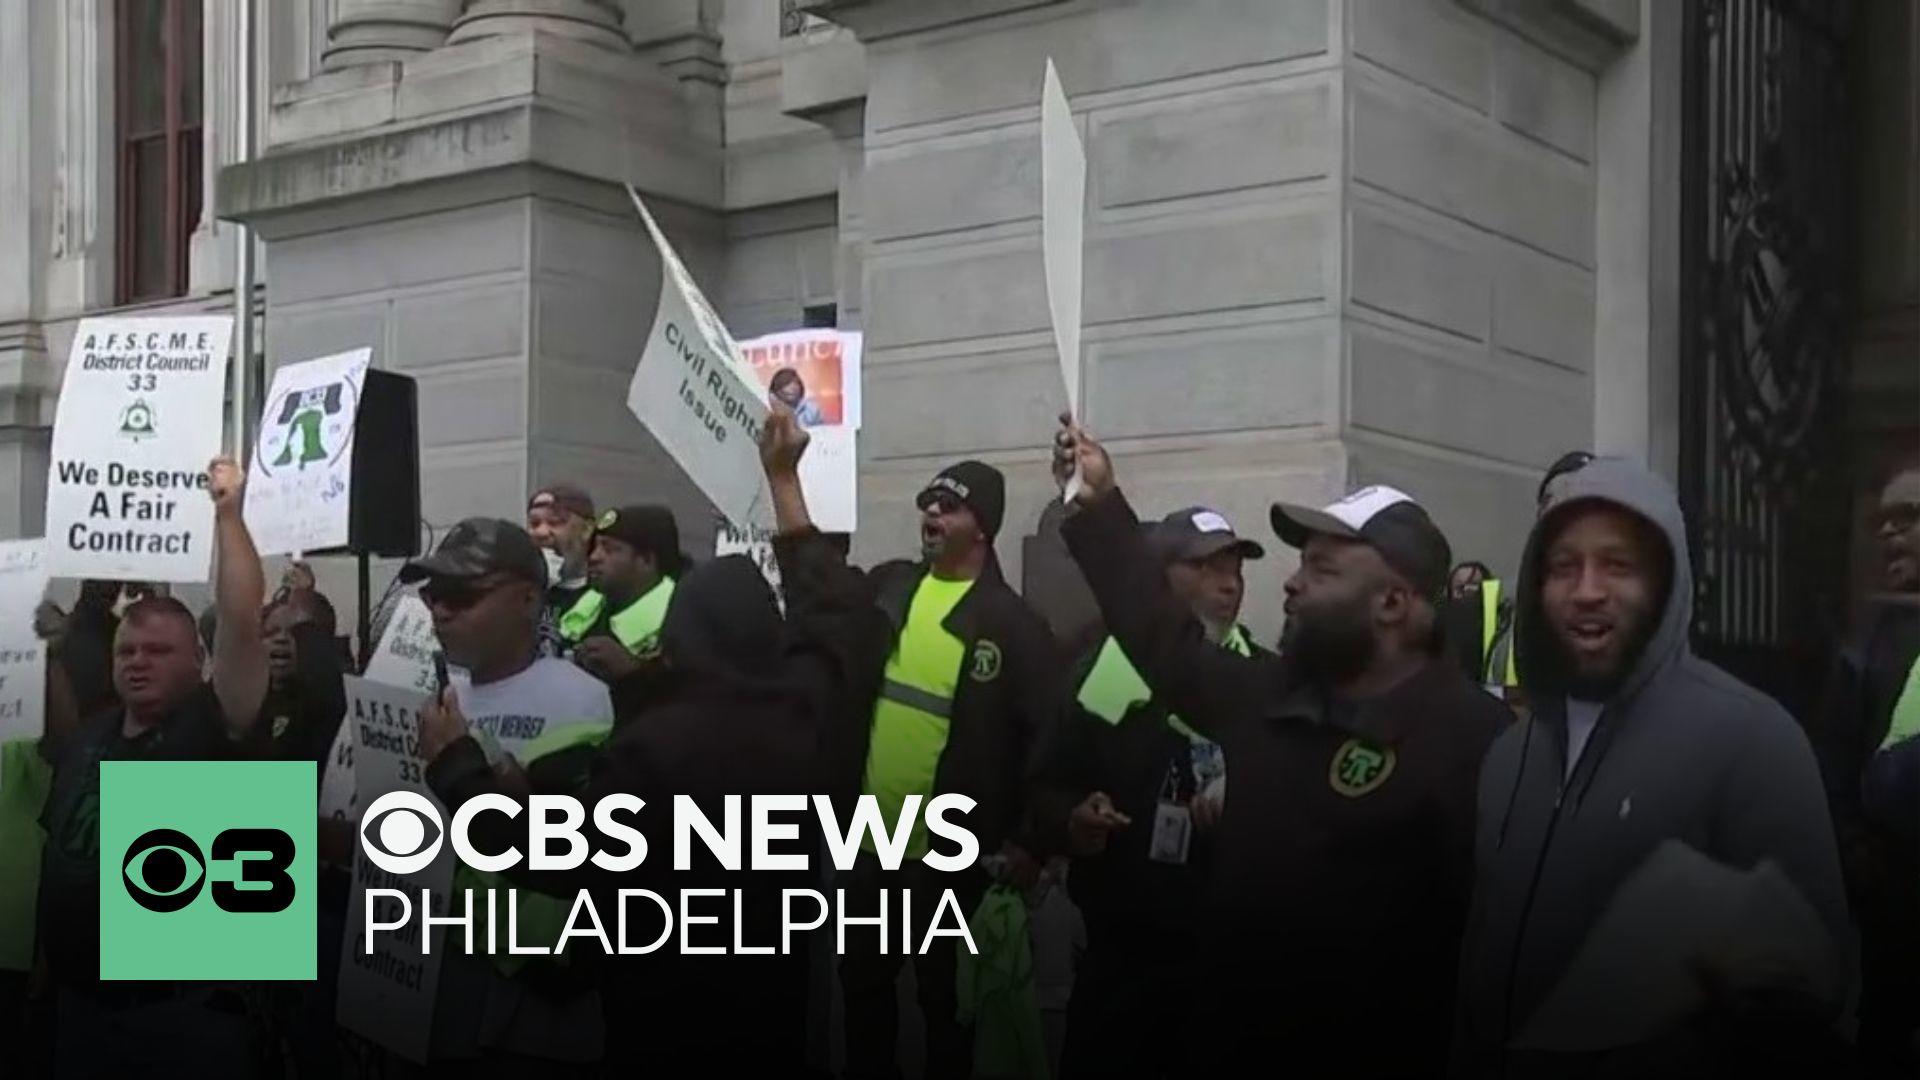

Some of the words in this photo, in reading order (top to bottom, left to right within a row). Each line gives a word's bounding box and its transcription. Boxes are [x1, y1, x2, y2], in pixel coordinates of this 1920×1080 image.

[82, 353, 143, 371] District
[146, 353, 210, 371] Council
[665, 322, 706, 376] Civil
[126, 373, 157, 392] 33
[678, 378, 727, 443] Issue
[58, 461, 99, 485] We
[107, 463, 210, 489] Deserve
[89, 491, 110, 518] A
[121, 492, 177, 520] Fair
[68, 523, 192, 554] Contract
[360, 724, 405, 755] District
[399, 760, 421, 784] 33
